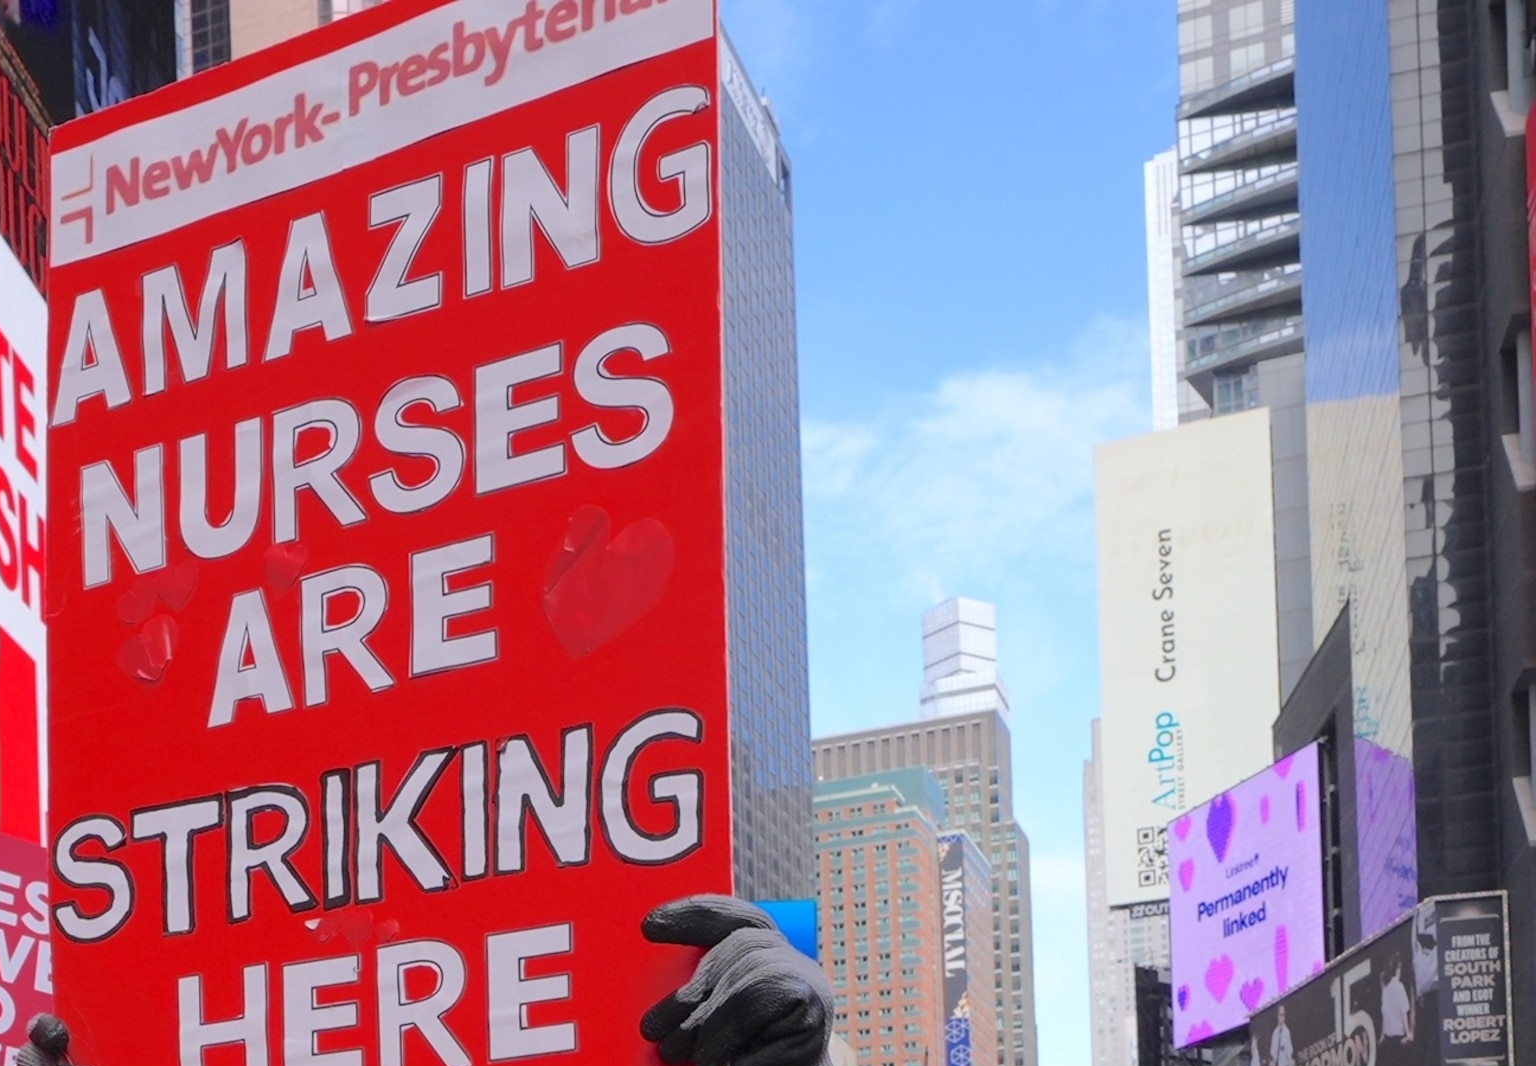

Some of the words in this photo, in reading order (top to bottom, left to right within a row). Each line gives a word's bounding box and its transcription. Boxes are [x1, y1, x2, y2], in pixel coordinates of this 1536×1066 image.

[49, 84, 711, 429] AMAZING
[79, 321, 675, 591] NURSES
[1154, 528, 1172, 600] Seven
[206, 531, 500, 729] ARE
[1154, 607, 1176, 683] Crane
[1148, 711, 1180, 811] ArtPop
[51, 707, 704, 944] STRIKING
[1197, 865, 1288, 922] Permanently
[1223, 899, 1266, 939] linked
[1444, 948, 1487, 963] CREATORS
[1488, 947, 1499, 960] OF
[1452, 935, 1475, 947] FROM
[1475, 933, 1491, 945] THE
[1444, 960, 1501, 976] SOUTH
[1451, 974, 1495, 989] PARK
[1452, 989, 1471, 1003] AND
[1456, 1003, 1490, 1016] WINNER
[1443, 1014, 1506, 1032] ROBERT
[1450, 1028, 1501, 1044] LOPEZ
